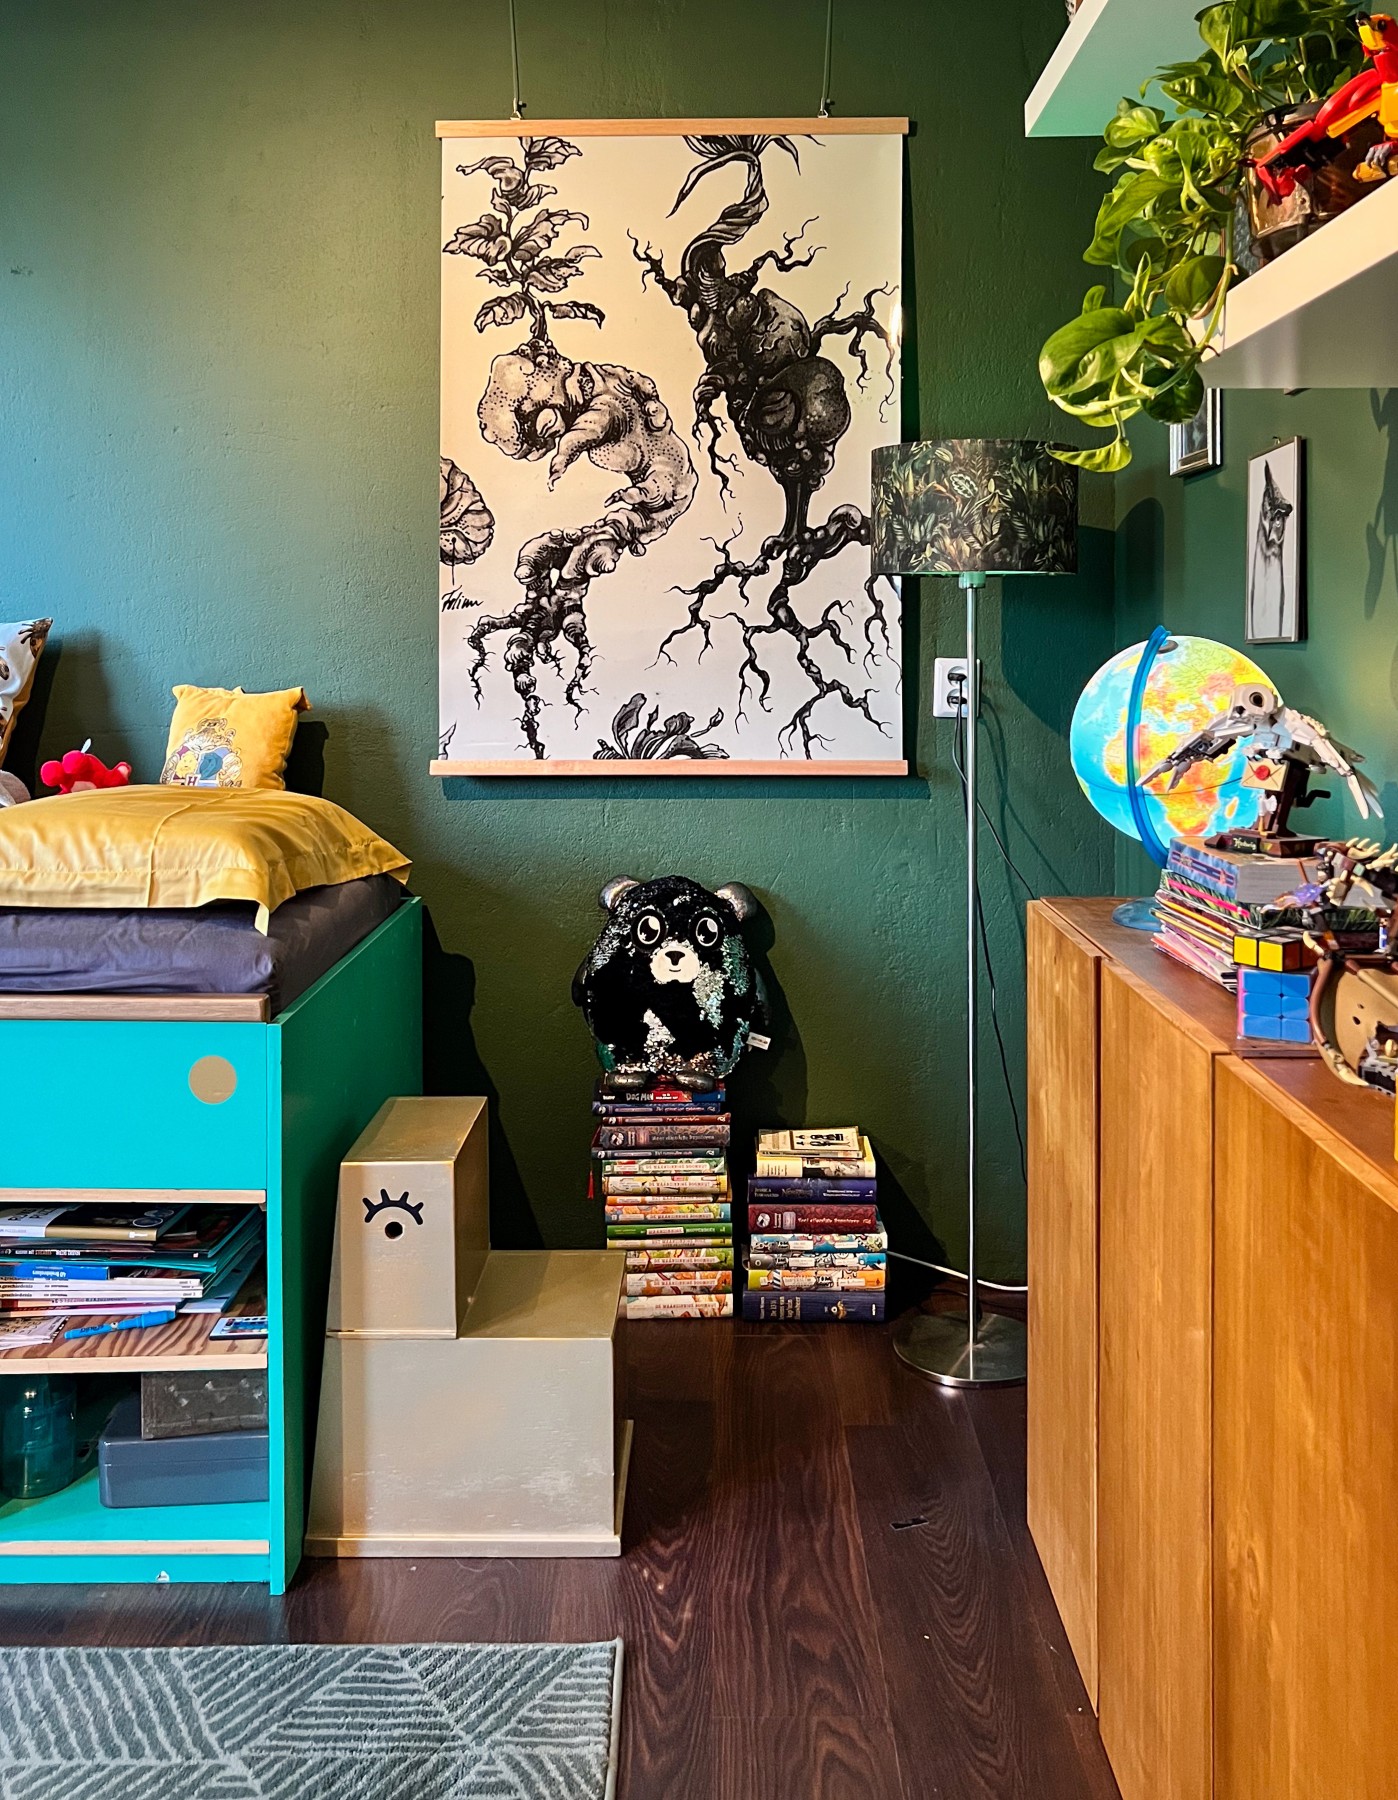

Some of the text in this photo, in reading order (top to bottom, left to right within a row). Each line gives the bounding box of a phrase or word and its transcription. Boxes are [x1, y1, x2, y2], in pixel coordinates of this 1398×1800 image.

[1232, 837, 1257, 850] Hedwig
[626, 1092, 640, 1101] DOG
[640, 1092, 654, 1101] MAN
